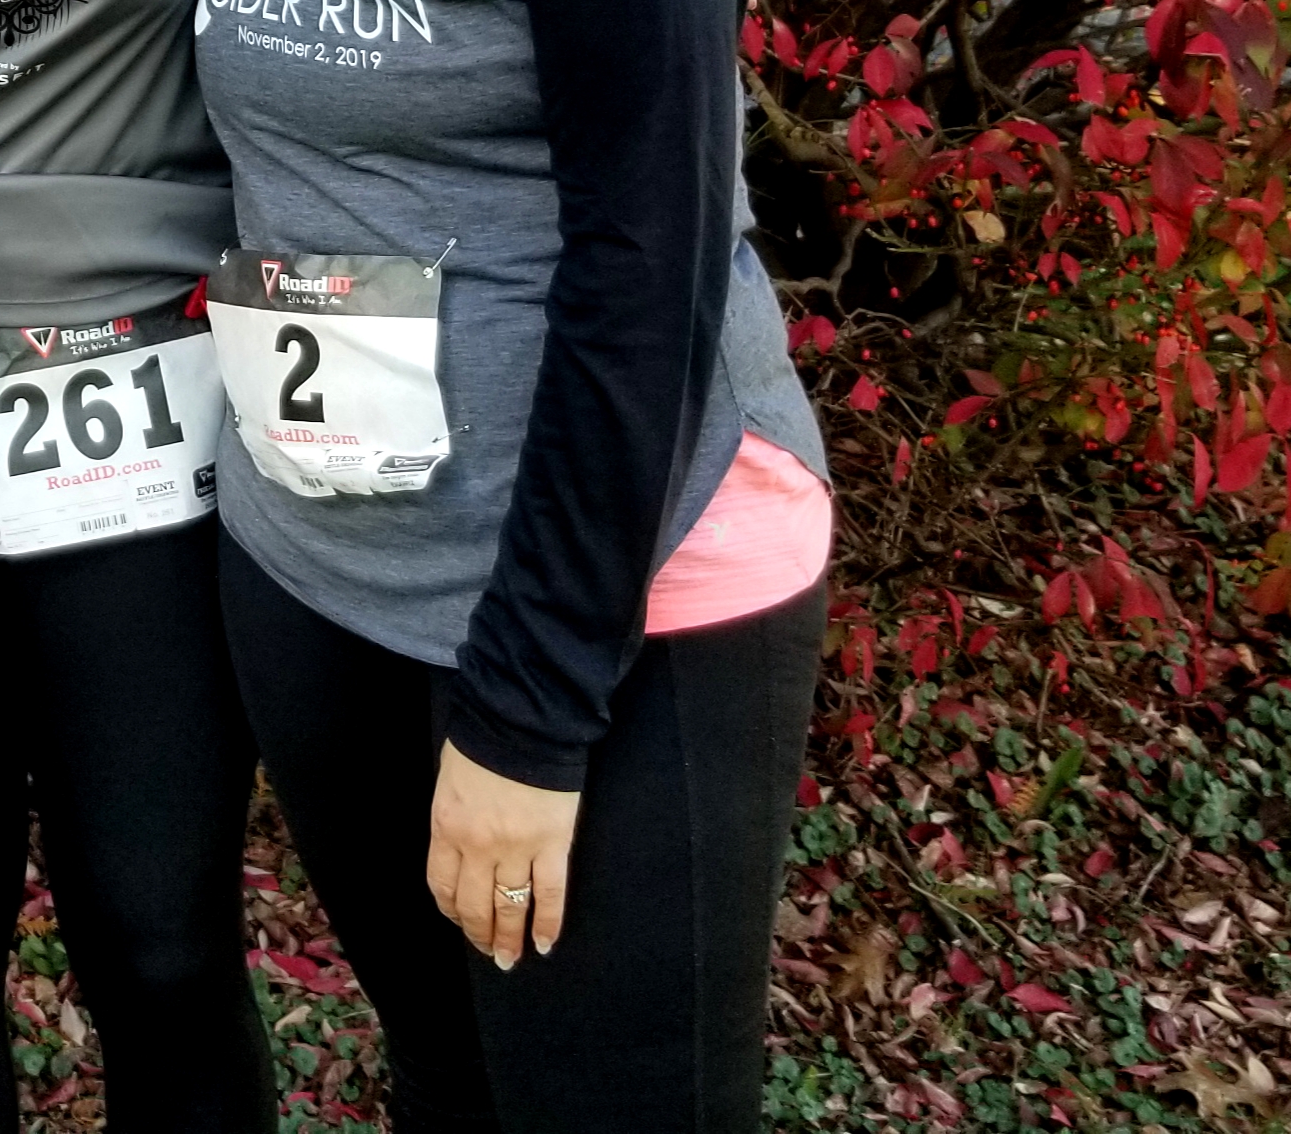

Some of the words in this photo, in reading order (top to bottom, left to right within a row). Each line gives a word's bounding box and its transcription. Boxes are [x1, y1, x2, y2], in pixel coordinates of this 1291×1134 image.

[237, 25, 312, 59] November
[314, 43, 331, 65] 2,
[335, 47, 382, 70] 2019
[279, 273, 352, 294] RoadID
[60, 316, 133, 345] RoadID
[275, 323, 325, 423] 2
[46, 458, 162, 491] RoadID.com
[136, 480, 176, 496] EVENT
